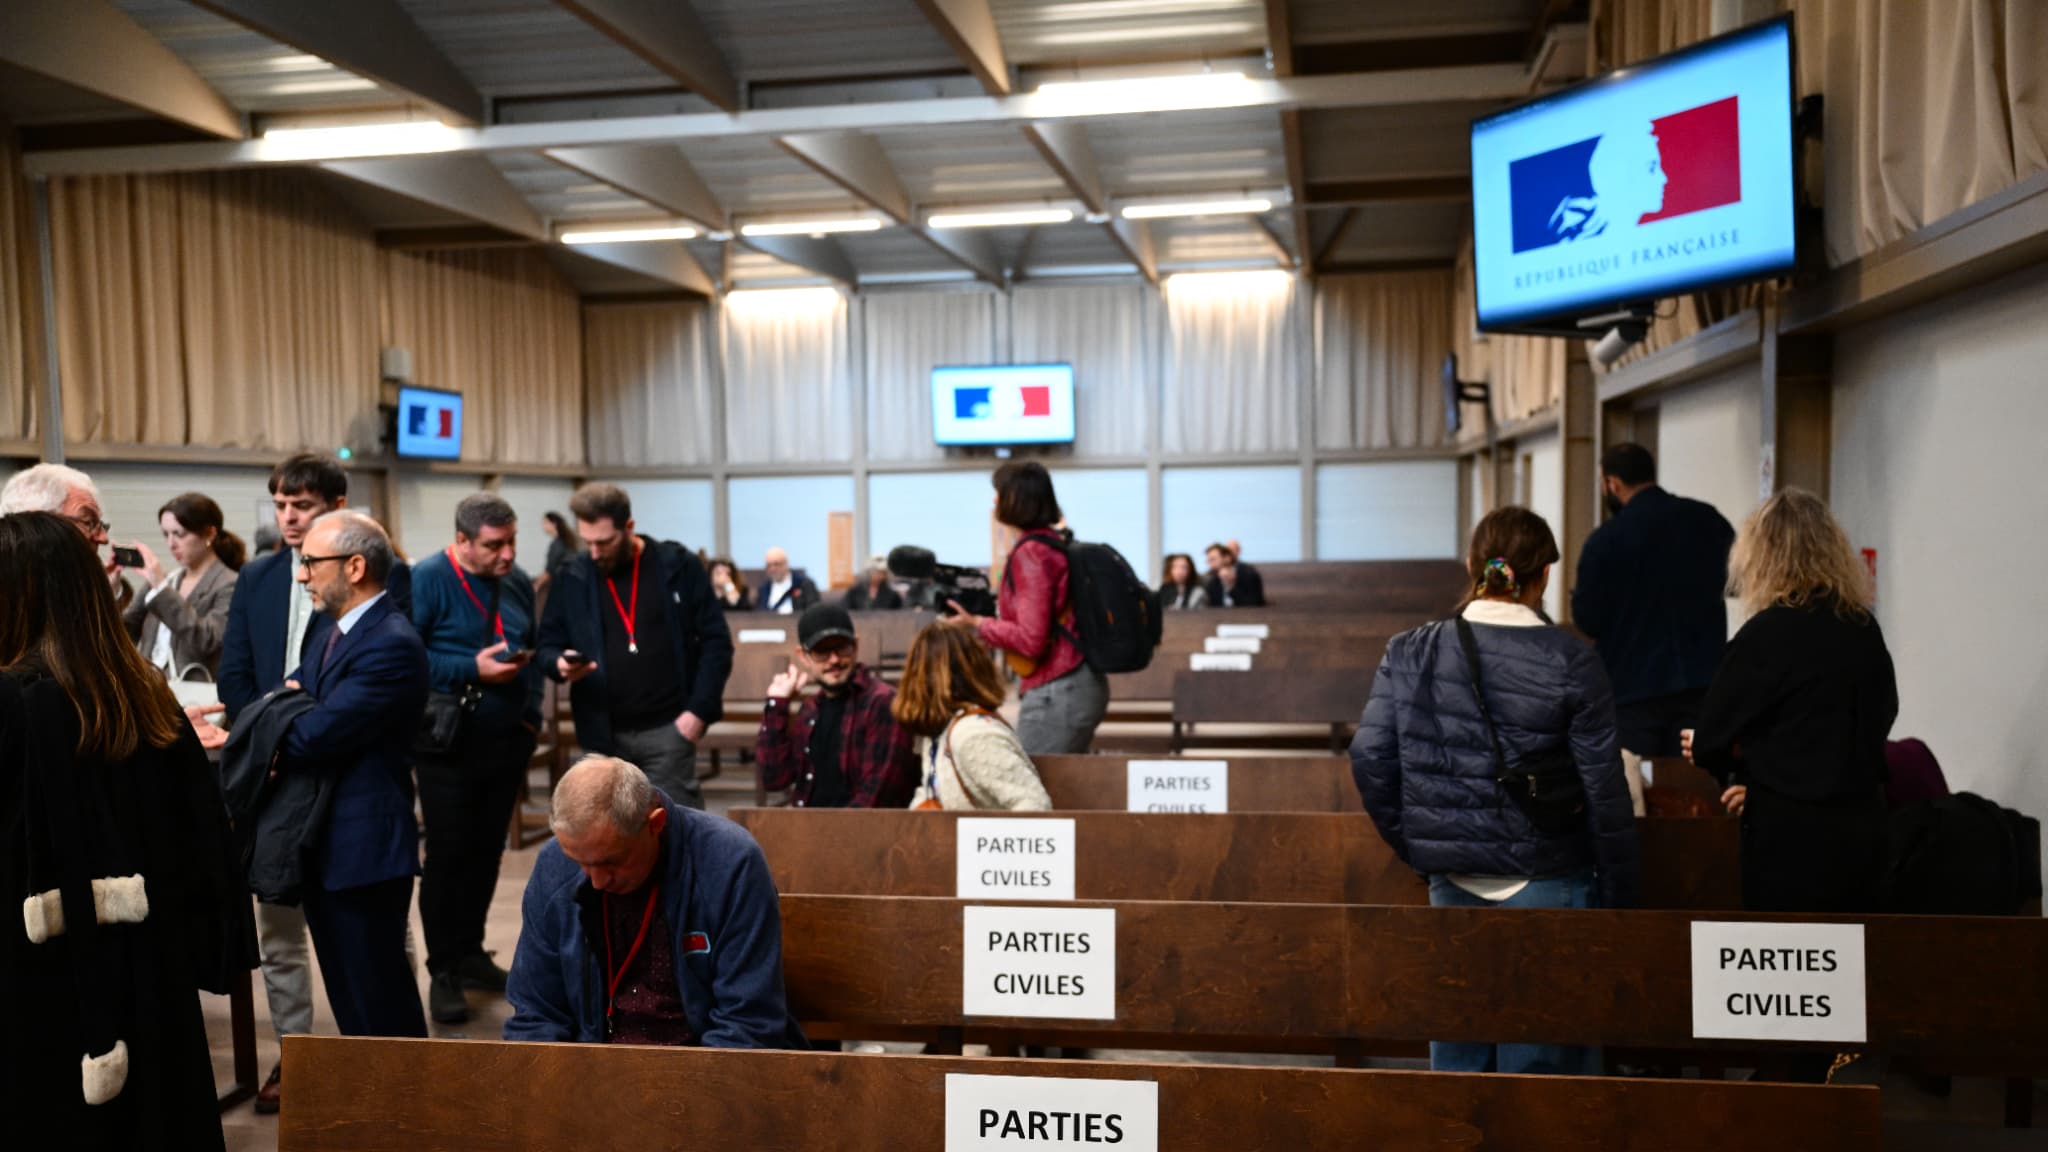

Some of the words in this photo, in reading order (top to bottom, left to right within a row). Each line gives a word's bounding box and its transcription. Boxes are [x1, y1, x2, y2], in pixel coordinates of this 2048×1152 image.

[1632, 229, 1740, 265] FRANÇAISE
[1144, 776, 1211, 791] PARTIES
[977, 837, 1056, 854] PARTIES
[980, 870, 1051, 887] CIVILES
[988, 931, 1091, 954] PARTIES
[1719, 947, 1838, 972] PARTIES
[993, 973, 1085, 996] CIVILES
[1726, 992, 1832, 1017] CIVILES
[979, 1108, 1124, 1144] PARTIES
